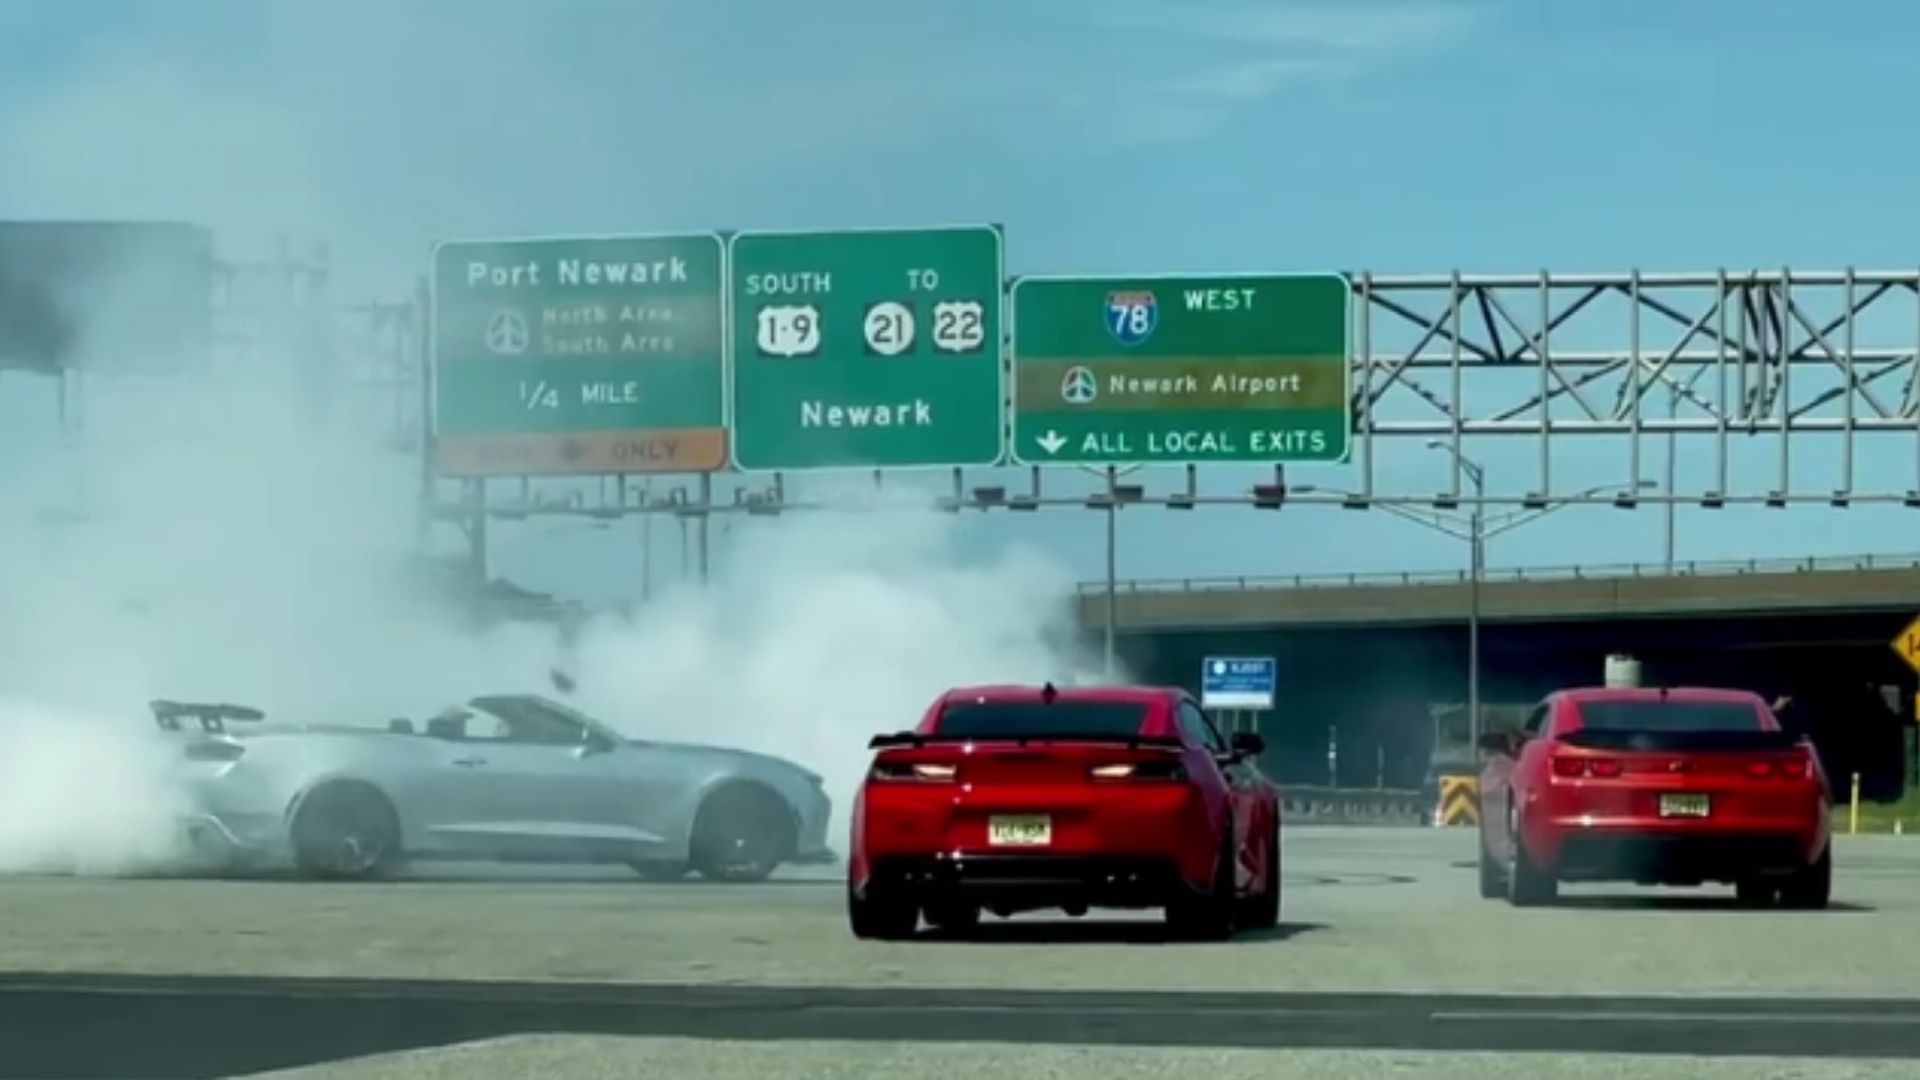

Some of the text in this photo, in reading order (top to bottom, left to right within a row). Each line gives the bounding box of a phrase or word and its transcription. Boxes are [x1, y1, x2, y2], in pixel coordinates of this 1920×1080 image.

[467, 256, 687, 286] Port Newark
[746, 272, 831, 294] SOUTH
[906, 269, 938, 291] TO
[1184, 289, 1256, 310] WEST
[873, 314, 903, 343] 21
[938, 311, 979, 340] 22
[1110, 305, 1148, 334] 78
[519, 381, 638, 410] 1/4 MILE
[1110, 373, 1301, 396] Newark Airport
[801, 400, 932, 427] Newark
[611, 439, 680, 462] ONLY
[1081, 430, 1326, 453] ALL LOCAL EXITS
